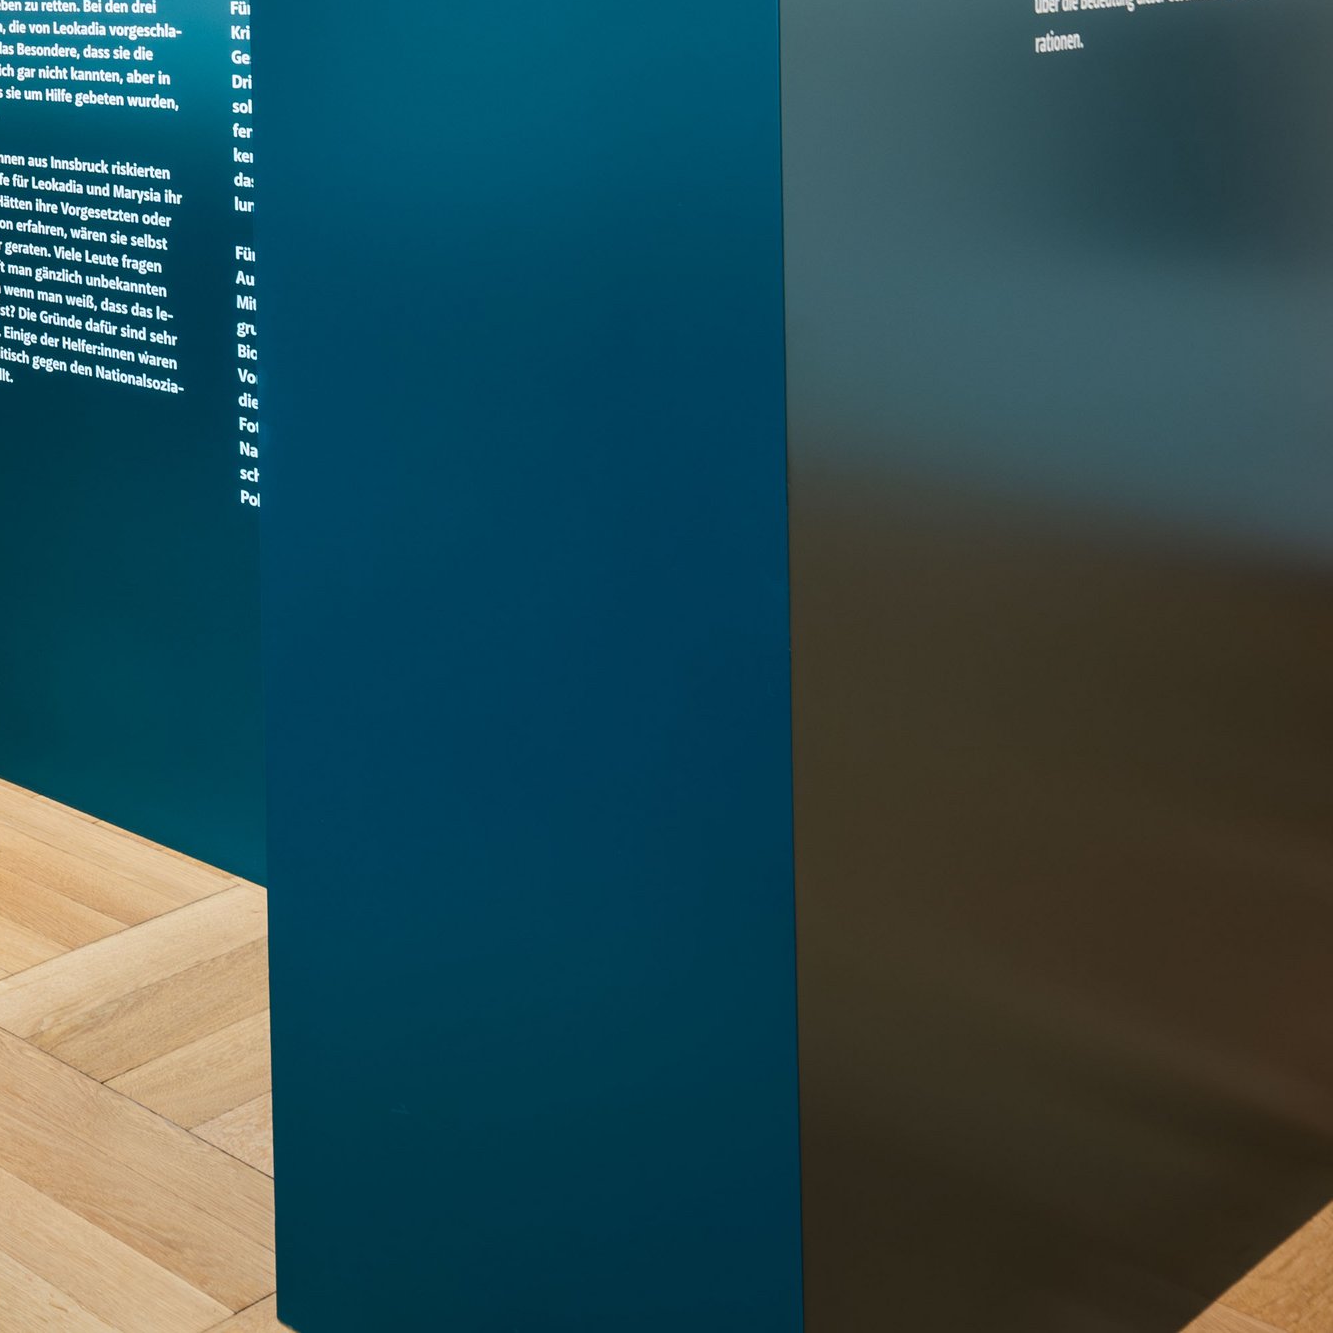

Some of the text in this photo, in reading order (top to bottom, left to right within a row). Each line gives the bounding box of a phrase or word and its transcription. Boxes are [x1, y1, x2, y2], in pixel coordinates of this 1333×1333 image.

[1035, 30, 1084, 53] rationen.
[27, 156, 48, 168] aus
[50, 155, 109, 174] Innsbruck
[111, 160, 171, 180] riskierten
